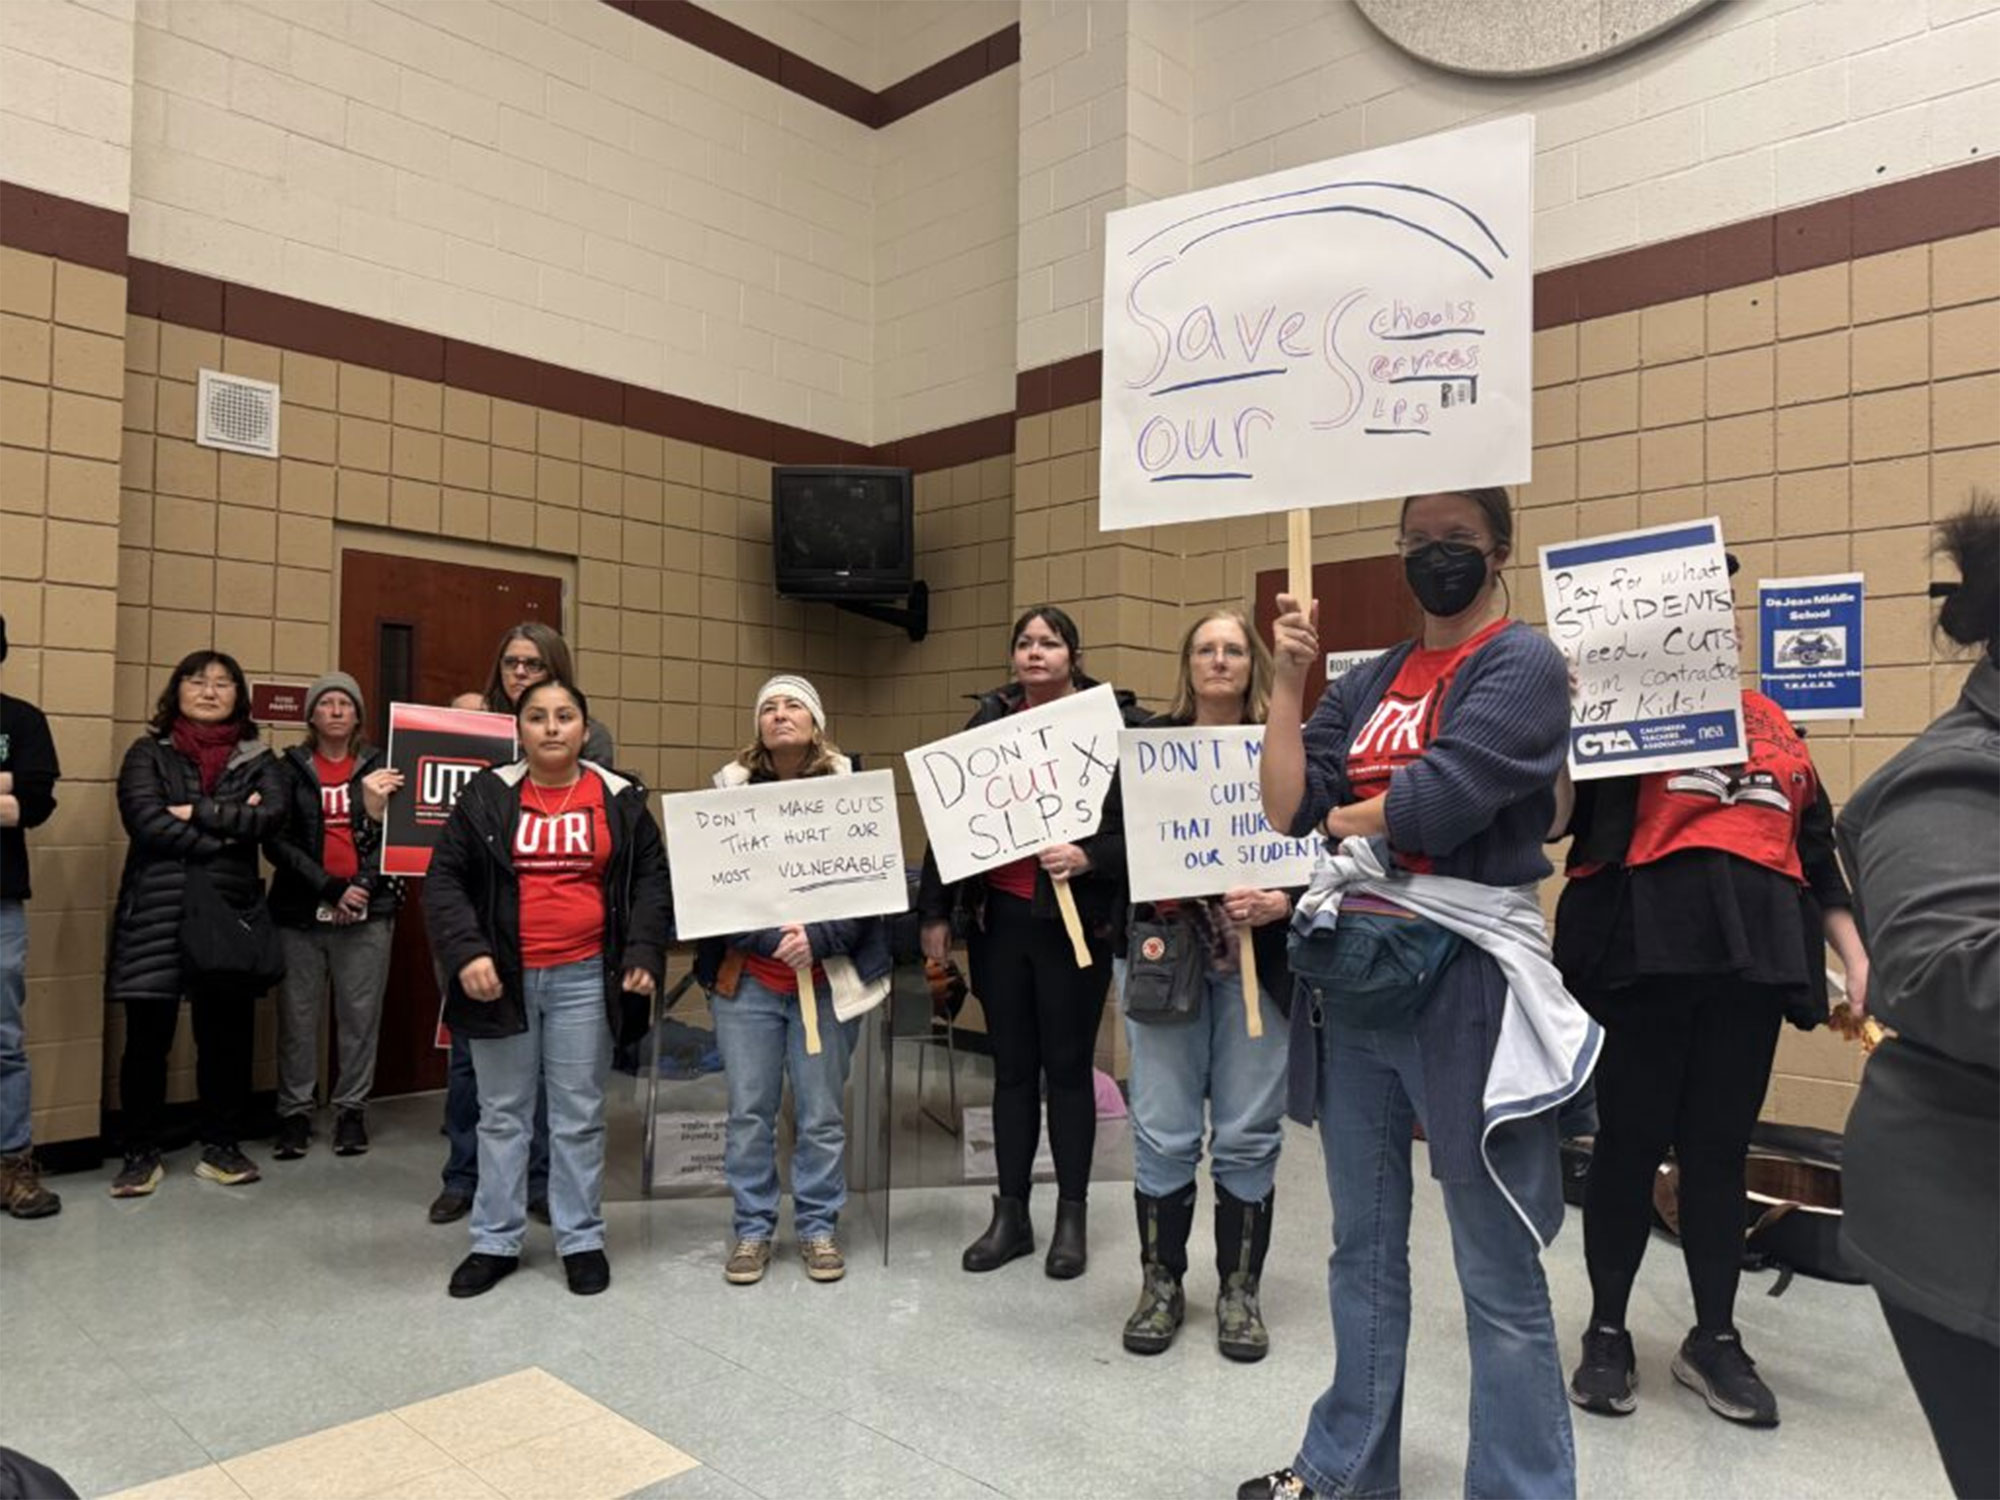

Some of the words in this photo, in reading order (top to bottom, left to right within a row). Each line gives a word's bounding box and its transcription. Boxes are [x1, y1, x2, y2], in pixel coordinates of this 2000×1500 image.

[1126, 257, 1314, 389] Save
[1138, 406, 1275, 472] our
[1555, 572, 1600, 606] Pay
[1661, 559, 1721, 585] what
[1813, 593, 1855, 605] Middle
[1554, 590, 1732, 639] STUDENTS
[1789, 609, 1831, 621] School
[1663, 626, 1736, 656] CUTS
[1349, 688, 1433, 754] UTR
[1571, 699, 1618, 724] NOT
[1635, 690, 1706, 721] Kids!
[1577, 730, 1639, 756] CTA
[1698, 725, 1724, 740] nea
[923, 725, 1053, 809] DON'T
[1137, 739, 1224, 775] DON'T
[985, 759, 1060, 809] CUT
[1210, 782, 1261, 805] CUTS
[696, 808, 756, 829] DON'T
[779, 799, 825, 818] MAKE
[835, 796, 885, 815] CUTS
[516, 812, 590, 854] UTR
[720, 834, 771, 855] THAT
[784, 827, 831, 844] HURT
[847, 821, 879, 838] OUR
[1238, 836, 1321, 865] STUDENT
[711, 868, 751, 887] MOST
[778, 854, 898, 879] VULNERABLE
